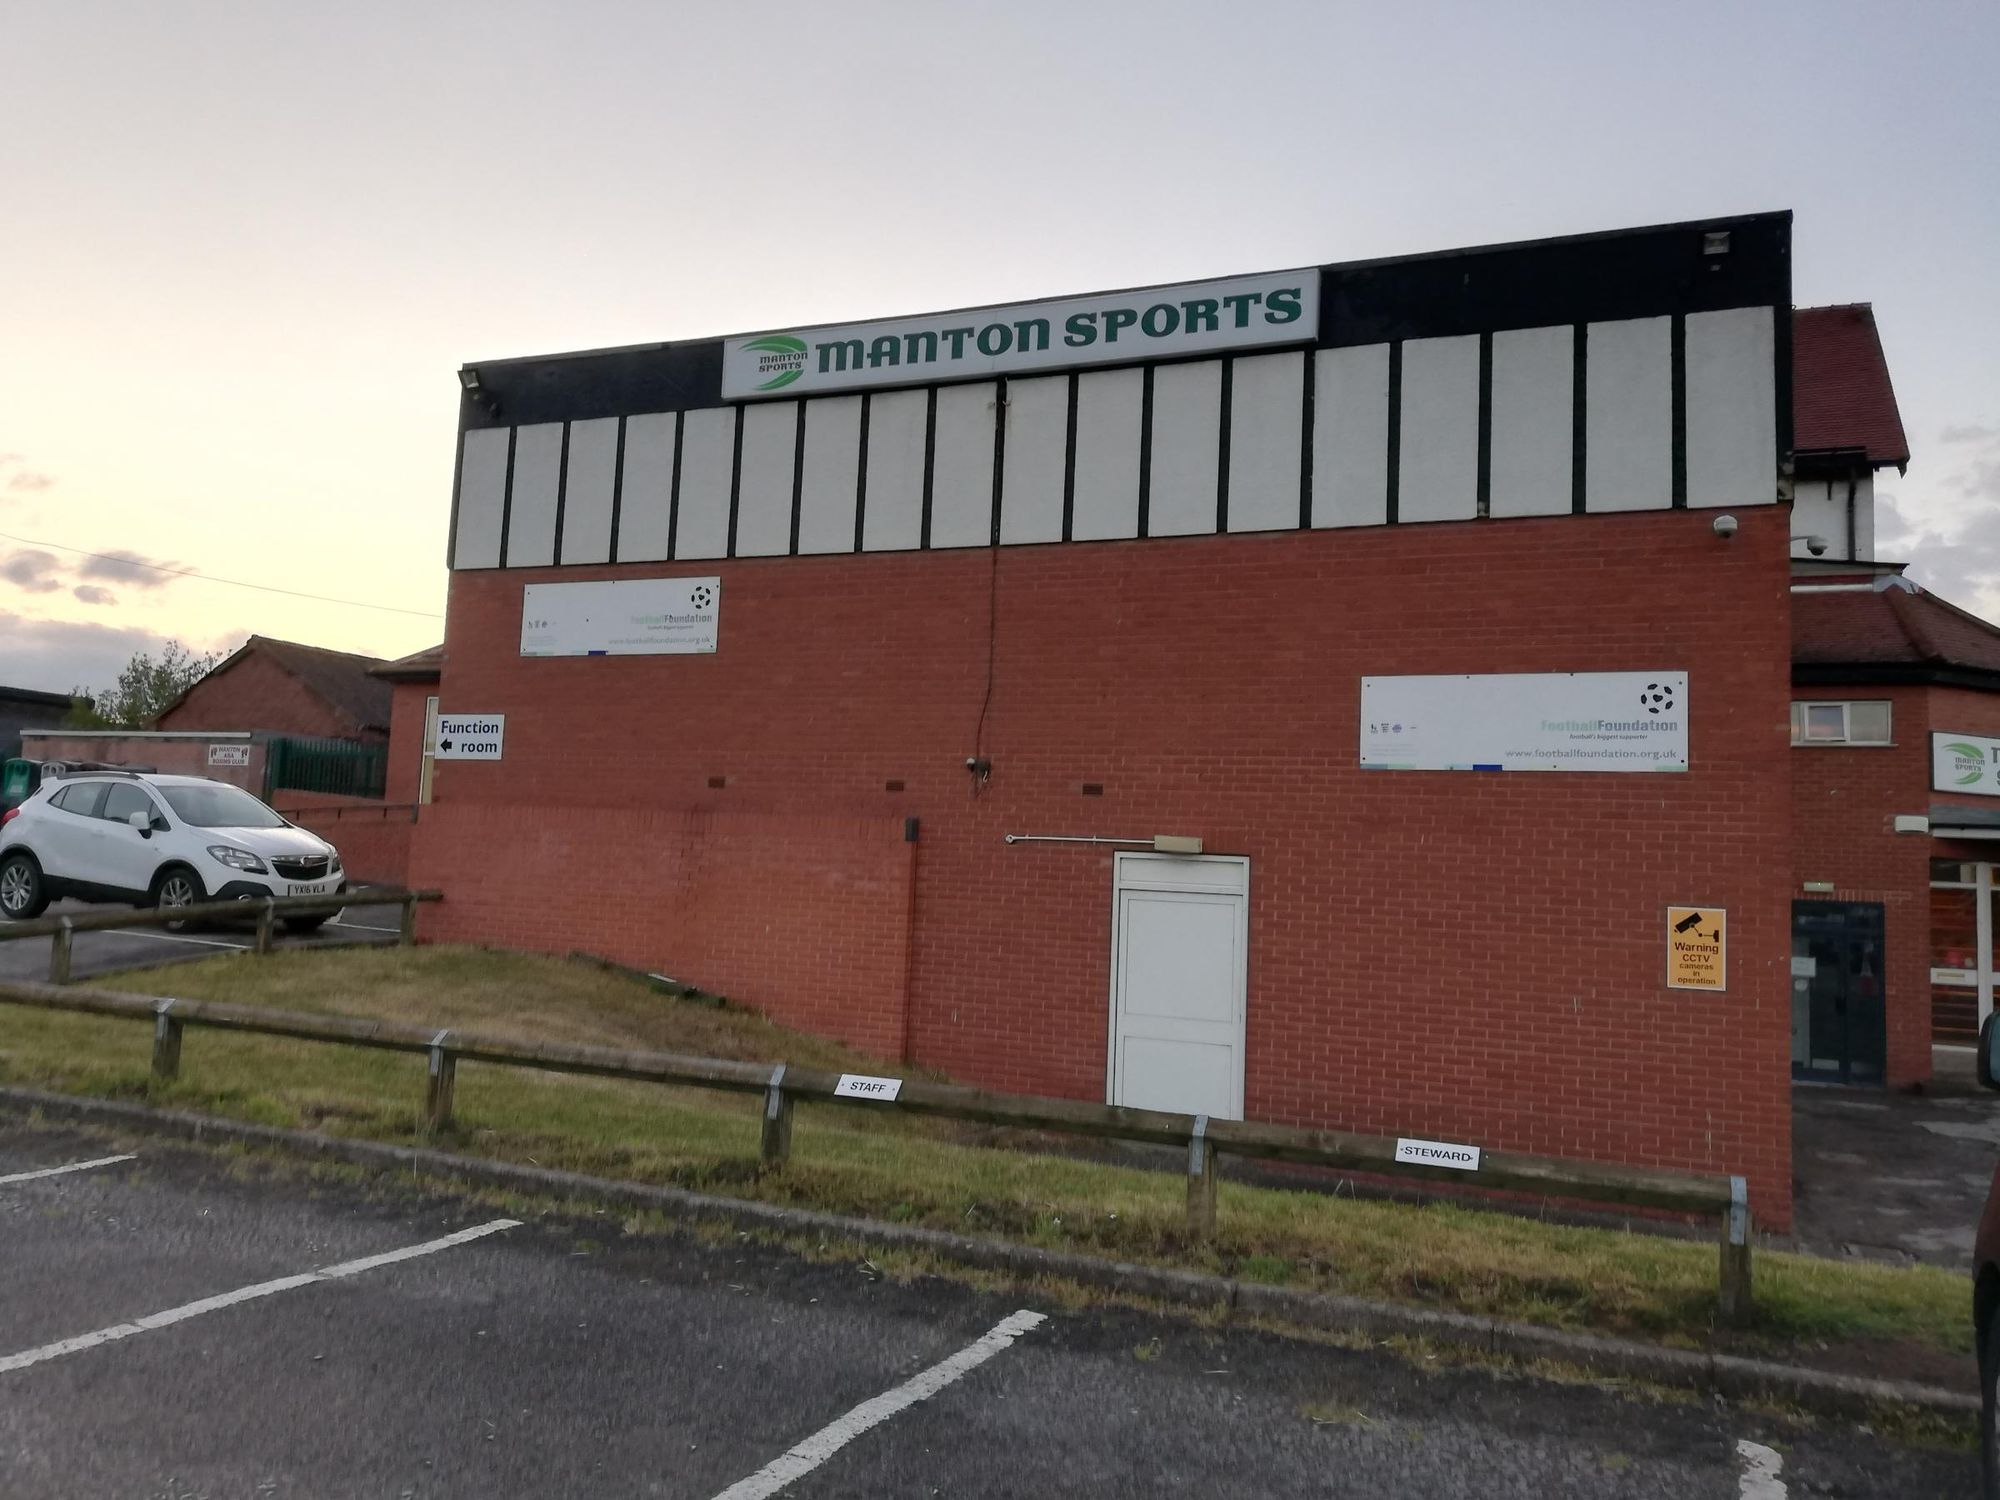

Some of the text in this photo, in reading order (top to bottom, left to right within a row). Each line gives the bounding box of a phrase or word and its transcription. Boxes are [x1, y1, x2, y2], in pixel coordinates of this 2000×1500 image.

[816, 288, 1302, 374] MANTON SPORTS
[760, 352, 808, 364] MANTON
[759, 361, 802, 373] SPORTS
[441, 720, 499, 734] Function
[461, 742, 498, 753] room
[1505, 749, 1677, 761] www.footballfoundation.org.uk
[1675, 942, 1719, 955] Warning
[1682, 953, 1710, 962] CCTV
[1679, 962, 1714, 970] cameras
[1677, 977, 1716, 985] operation
[850, 1081, 887, 1093] STAFF
[1404, 1146, 1471, 1161] STEWARD
